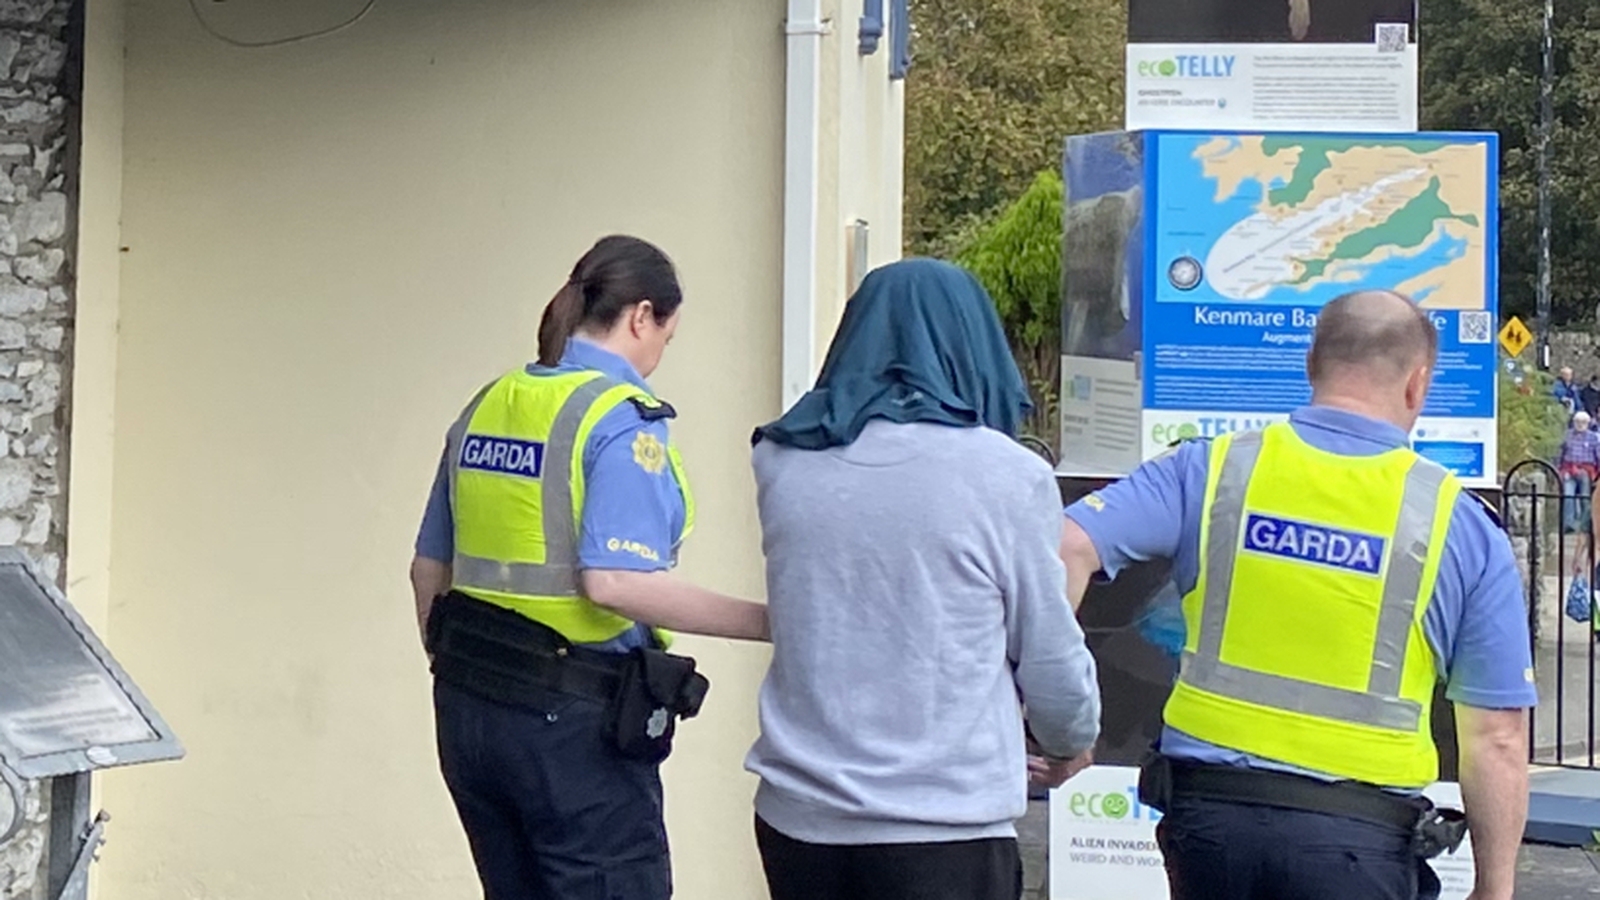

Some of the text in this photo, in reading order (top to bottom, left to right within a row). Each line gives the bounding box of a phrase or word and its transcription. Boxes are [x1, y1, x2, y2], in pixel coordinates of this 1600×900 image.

[1138, 55, 1235, 77] ecoTELLY
[1194, 306, 1285, 327] Kenmare
[1291, 307, 1317, 328] Ba
[1261, 331, 1313, 345] Augment
[464, 437, 536, 475] GARDA
[1250, 518, 1374, 570] GARDA
[1069, 837, 1106, 849] ALIEN
[1069, 852, 1107, 864] WEIRD
[1108, 854, 1135, 866] AND
